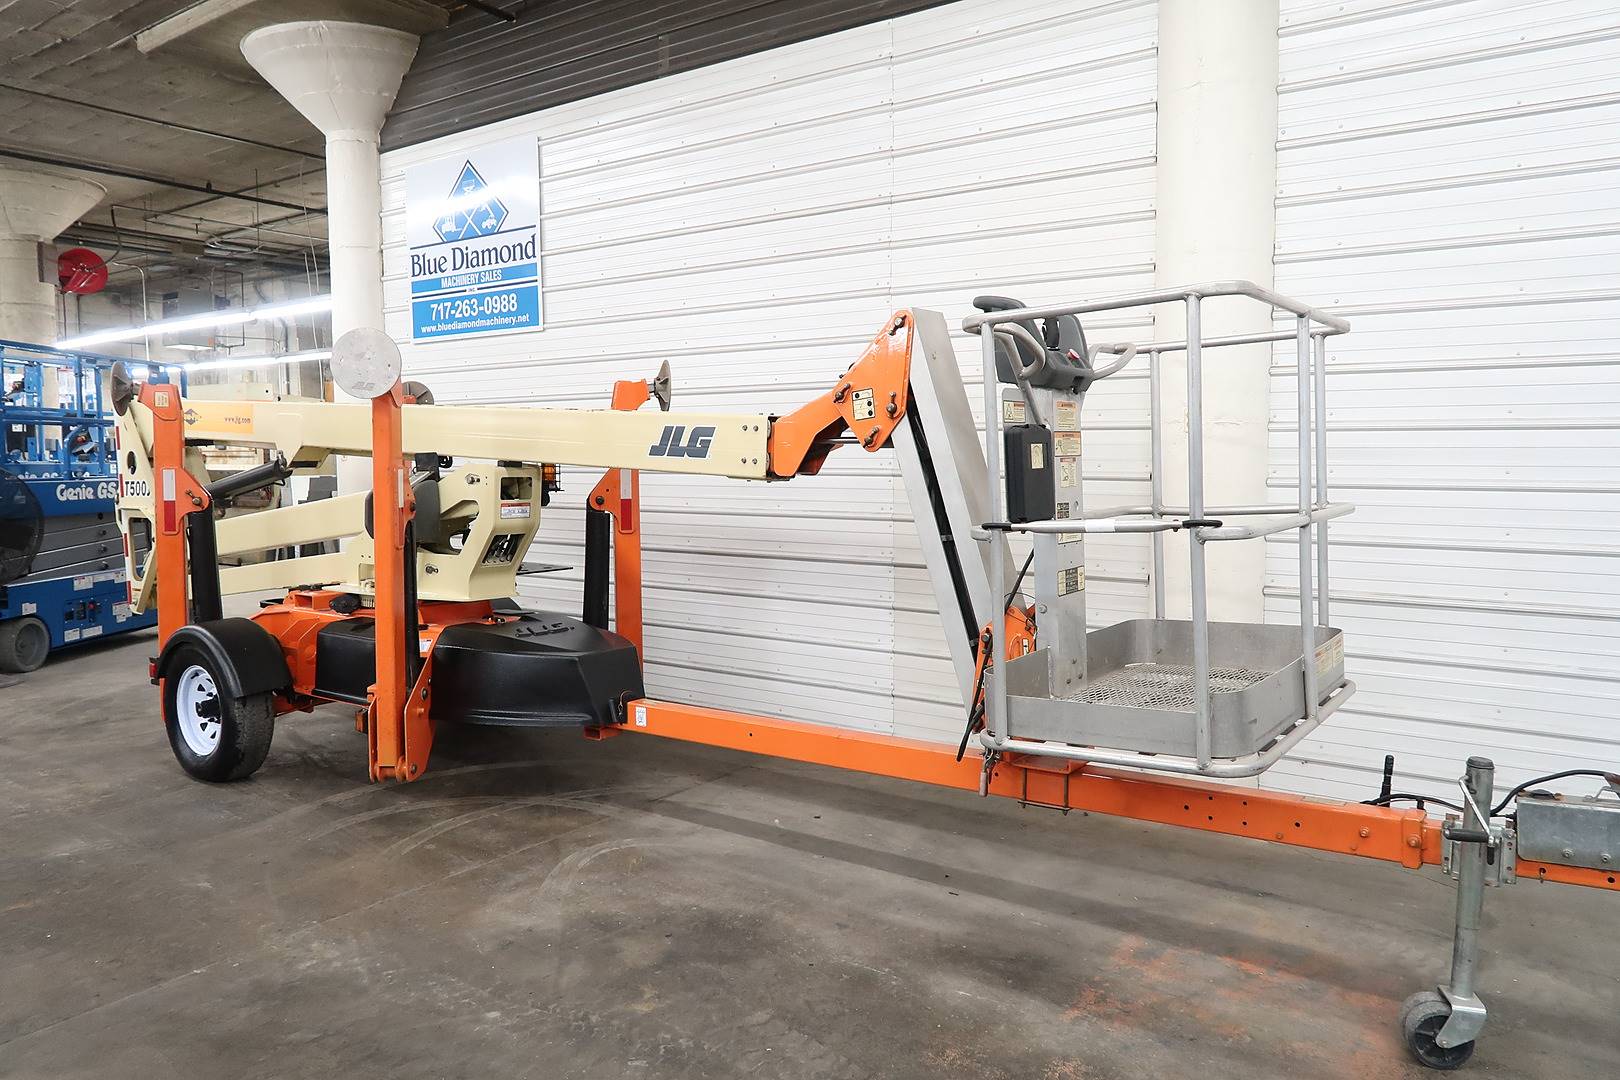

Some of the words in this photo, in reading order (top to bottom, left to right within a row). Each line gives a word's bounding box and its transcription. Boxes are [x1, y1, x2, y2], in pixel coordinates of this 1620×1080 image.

[411, 252, 447, 277] Blue
[451, 233, 537, 271] Diamond
[441, 272, 480, 289] MACHINERY
[480, 269, 502, 283] SALES
[430, 293, 518, 321] 717-263-0988
[420, 313, 530, 333] www.bluediamondmachinery.net
[648, 425, 716, 458] JLG
[56, 483, 94, 501] Genie
